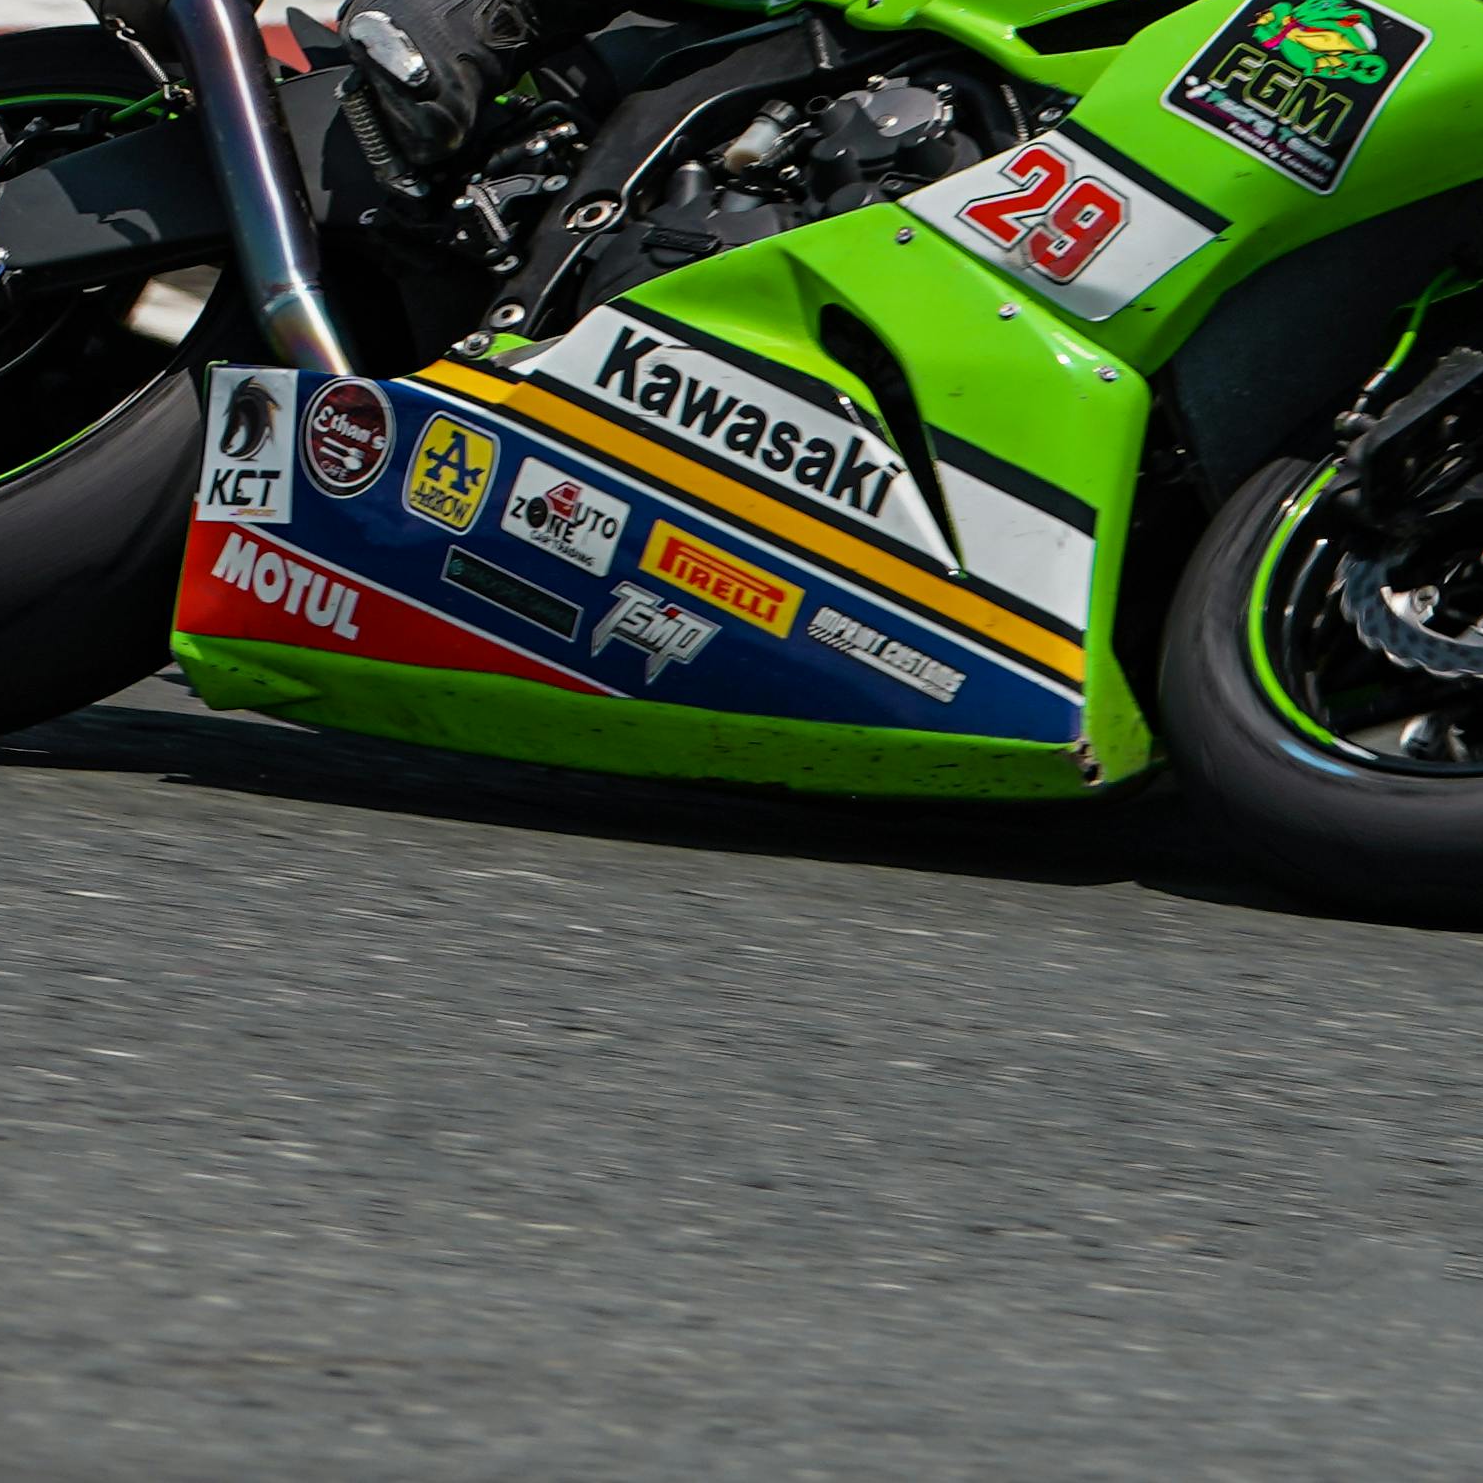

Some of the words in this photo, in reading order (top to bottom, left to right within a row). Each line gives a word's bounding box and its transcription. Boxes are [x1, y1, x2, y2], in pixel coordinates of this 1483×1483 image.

[1208, 42, 1354, 147] FGM
[954, 142, 1131, 287] 29
[595, 325, 907, 518] Kawasaki
[410, 481, 472, 522] ARROW
[211, 531, 360, 641] MOTUL
[657, 536, 788, 624] PIRELLI
